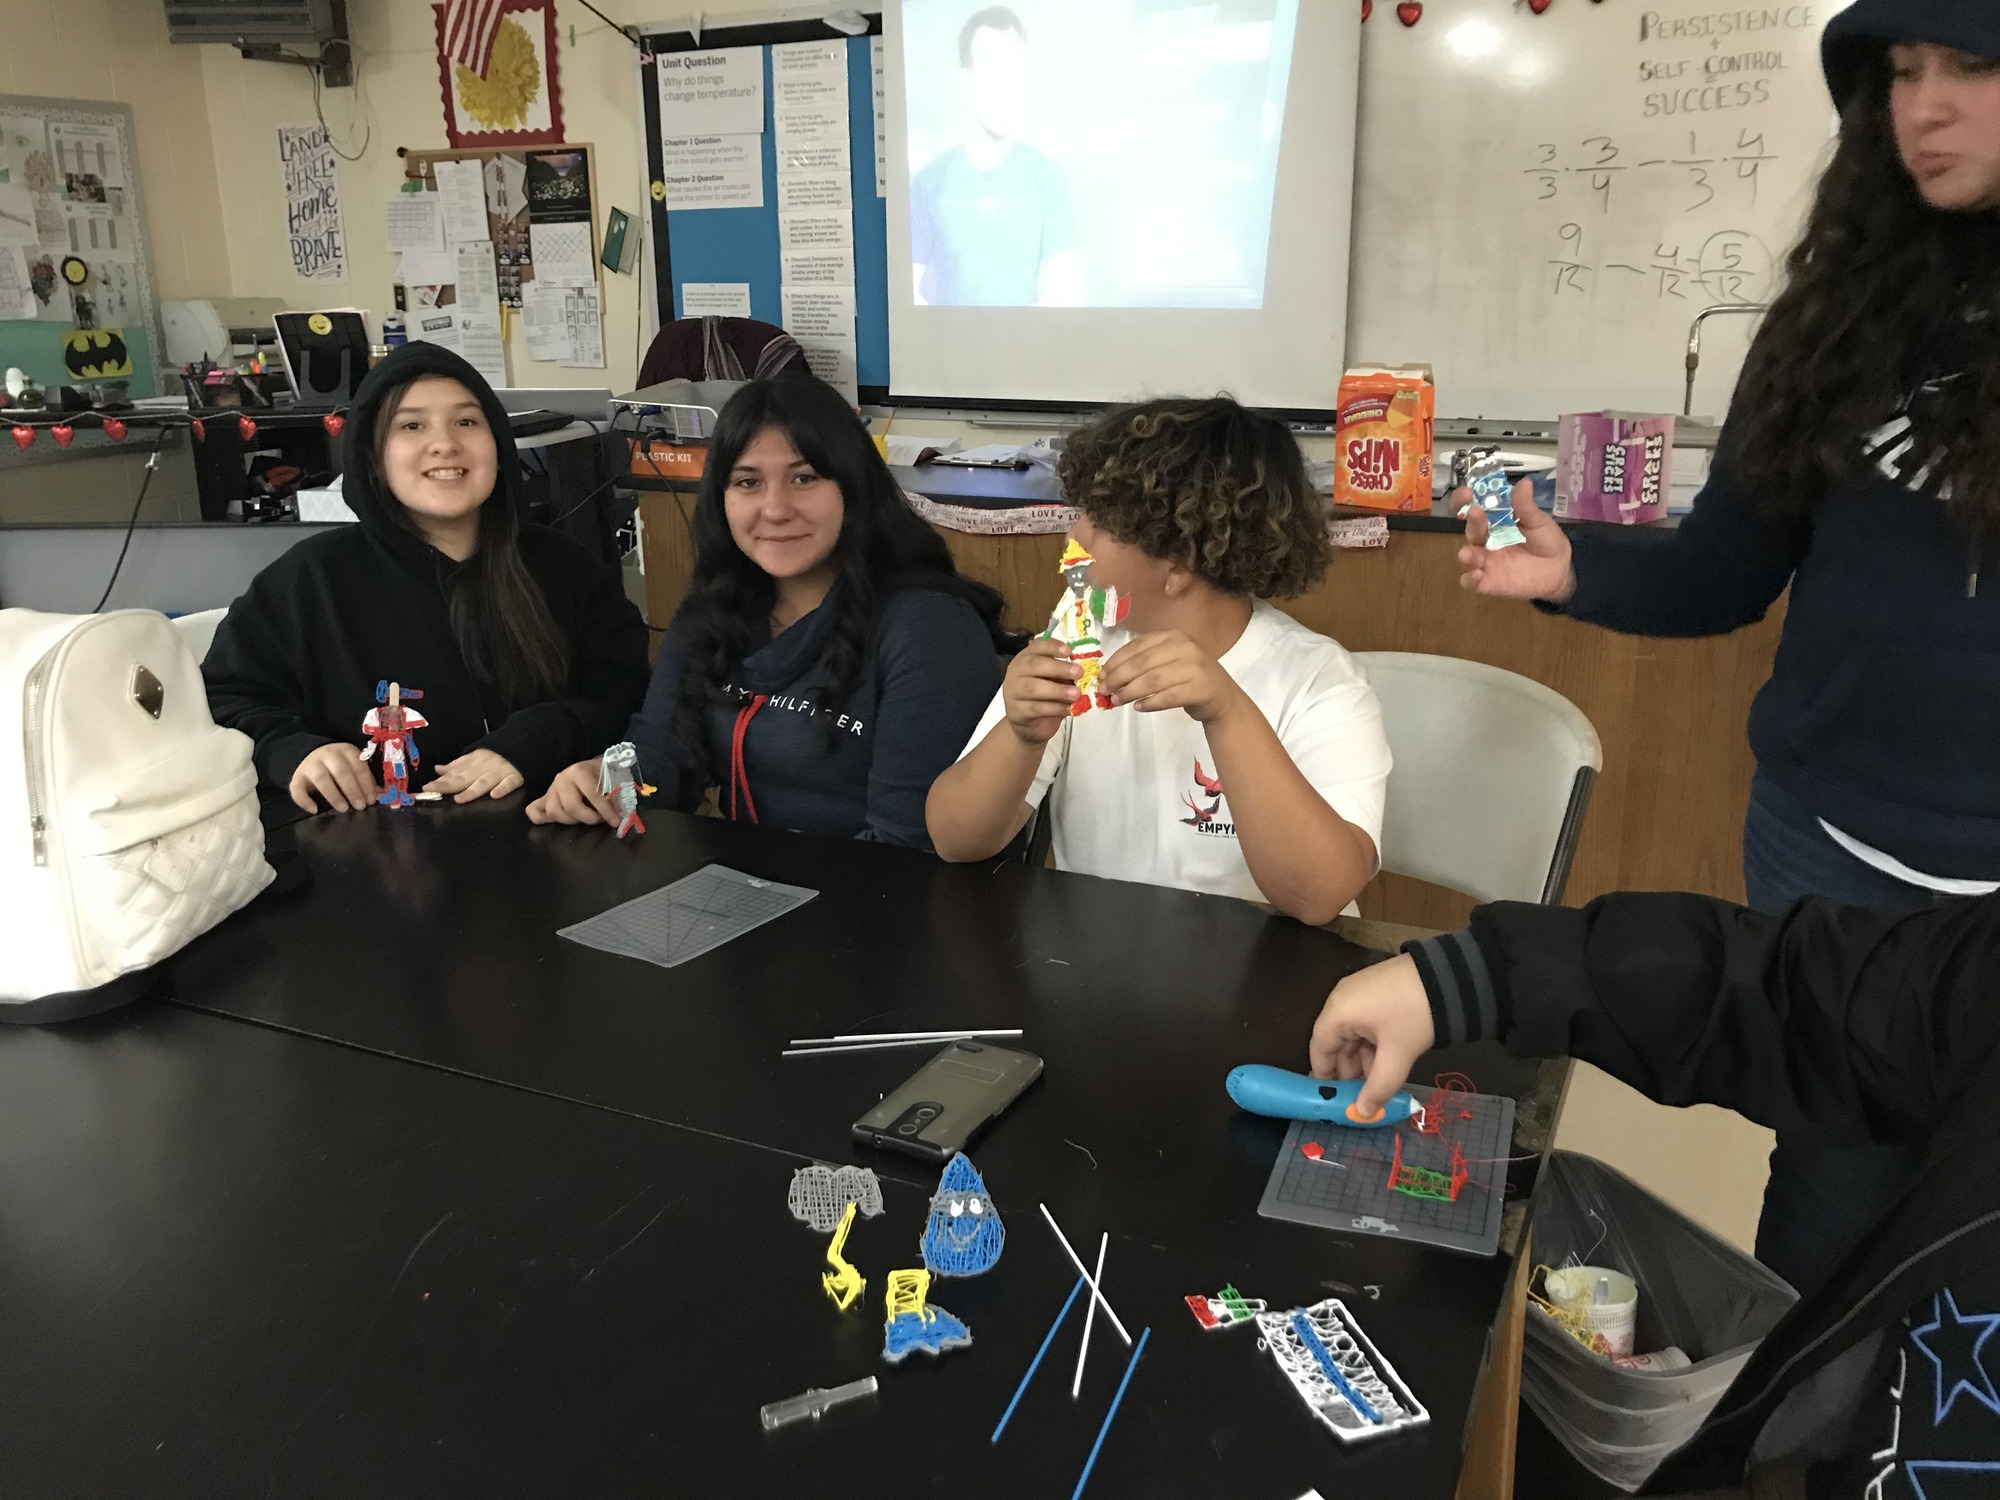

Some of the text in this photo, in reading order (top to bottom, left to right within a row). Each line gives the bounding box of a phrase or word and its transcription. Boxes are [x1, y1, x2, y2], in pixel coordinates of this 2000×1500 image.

[1639, 5, 1817, 42] PERSISTENCE
[662, 56, 726, 69] Unit Question
[1639, 50, 1790, 82] SELF CONTROL
[663, 74, 725, 89] Why do things
[664, 85, 757, 102] change temperature?
[1643, 78, 1770, 117] SUCCESS
[278, 128, 323, 162] LAND
[664, 139, 689, 148] Chapter
[694, 137, 722, 146] Question
[297, 151, 334, 195] FREE
[666, 176, 690, 185] Chapter
[697, 174, 724, 183] Question
[290, 231, 343, 272] BRAVE
[635, 451, 692, 463] PLASTIC KIT
[1603, 445, 1615, 493] STICKS
[1615, 446, 1627, 494] CRAFT
[1640, 437, 1656, 504] CRAFT
[1648, 435, 1663, 503] STICKS
[992, 525, 1017, 533] LOVE
[1031, 509, 1057, 518] LOVE
[1069, 512, 1081, 521] LO
